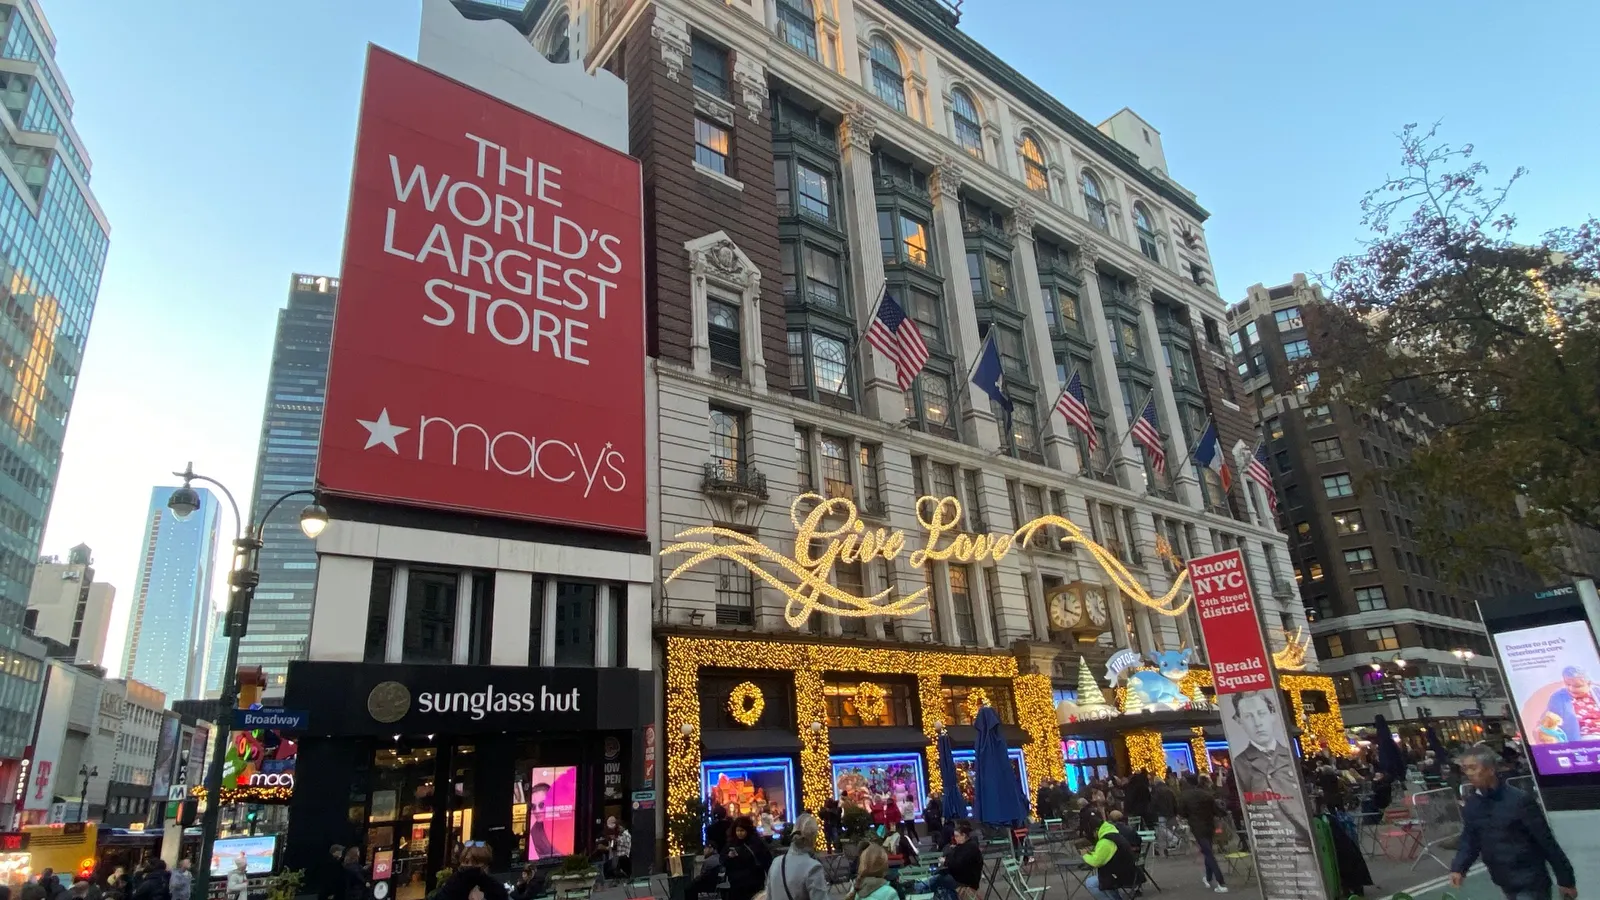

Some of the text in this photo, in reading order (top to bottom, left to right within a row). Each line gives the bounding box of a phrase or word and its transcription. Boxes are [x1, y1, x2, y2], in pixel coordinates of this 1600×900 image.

[465, 132, 562, 208] THE
[388, 154, 622, 274] WORLD'S
[382, 207, 618, 319] LARGEST
[422, 278, 590, 366] STORE
[785, 492, 1015, 628] Give Love
[1191, 557, 1238, 577] know
[1195, 570, 1244, 595] NYC
[1534, 586, 1573, 599] LinkNYC
[1200, 592, 1248, 608] 34th Street
[1202, 601, 1251, 619] district
[1111, 651, 1136, 674] TIPTOE
[1214, 657, 1263, 674] Herald
[1217, 672, 1266, 689] Square
[418, 684, 581, 720] sunglass hut
[244, 714, 300, 727] Broadway
